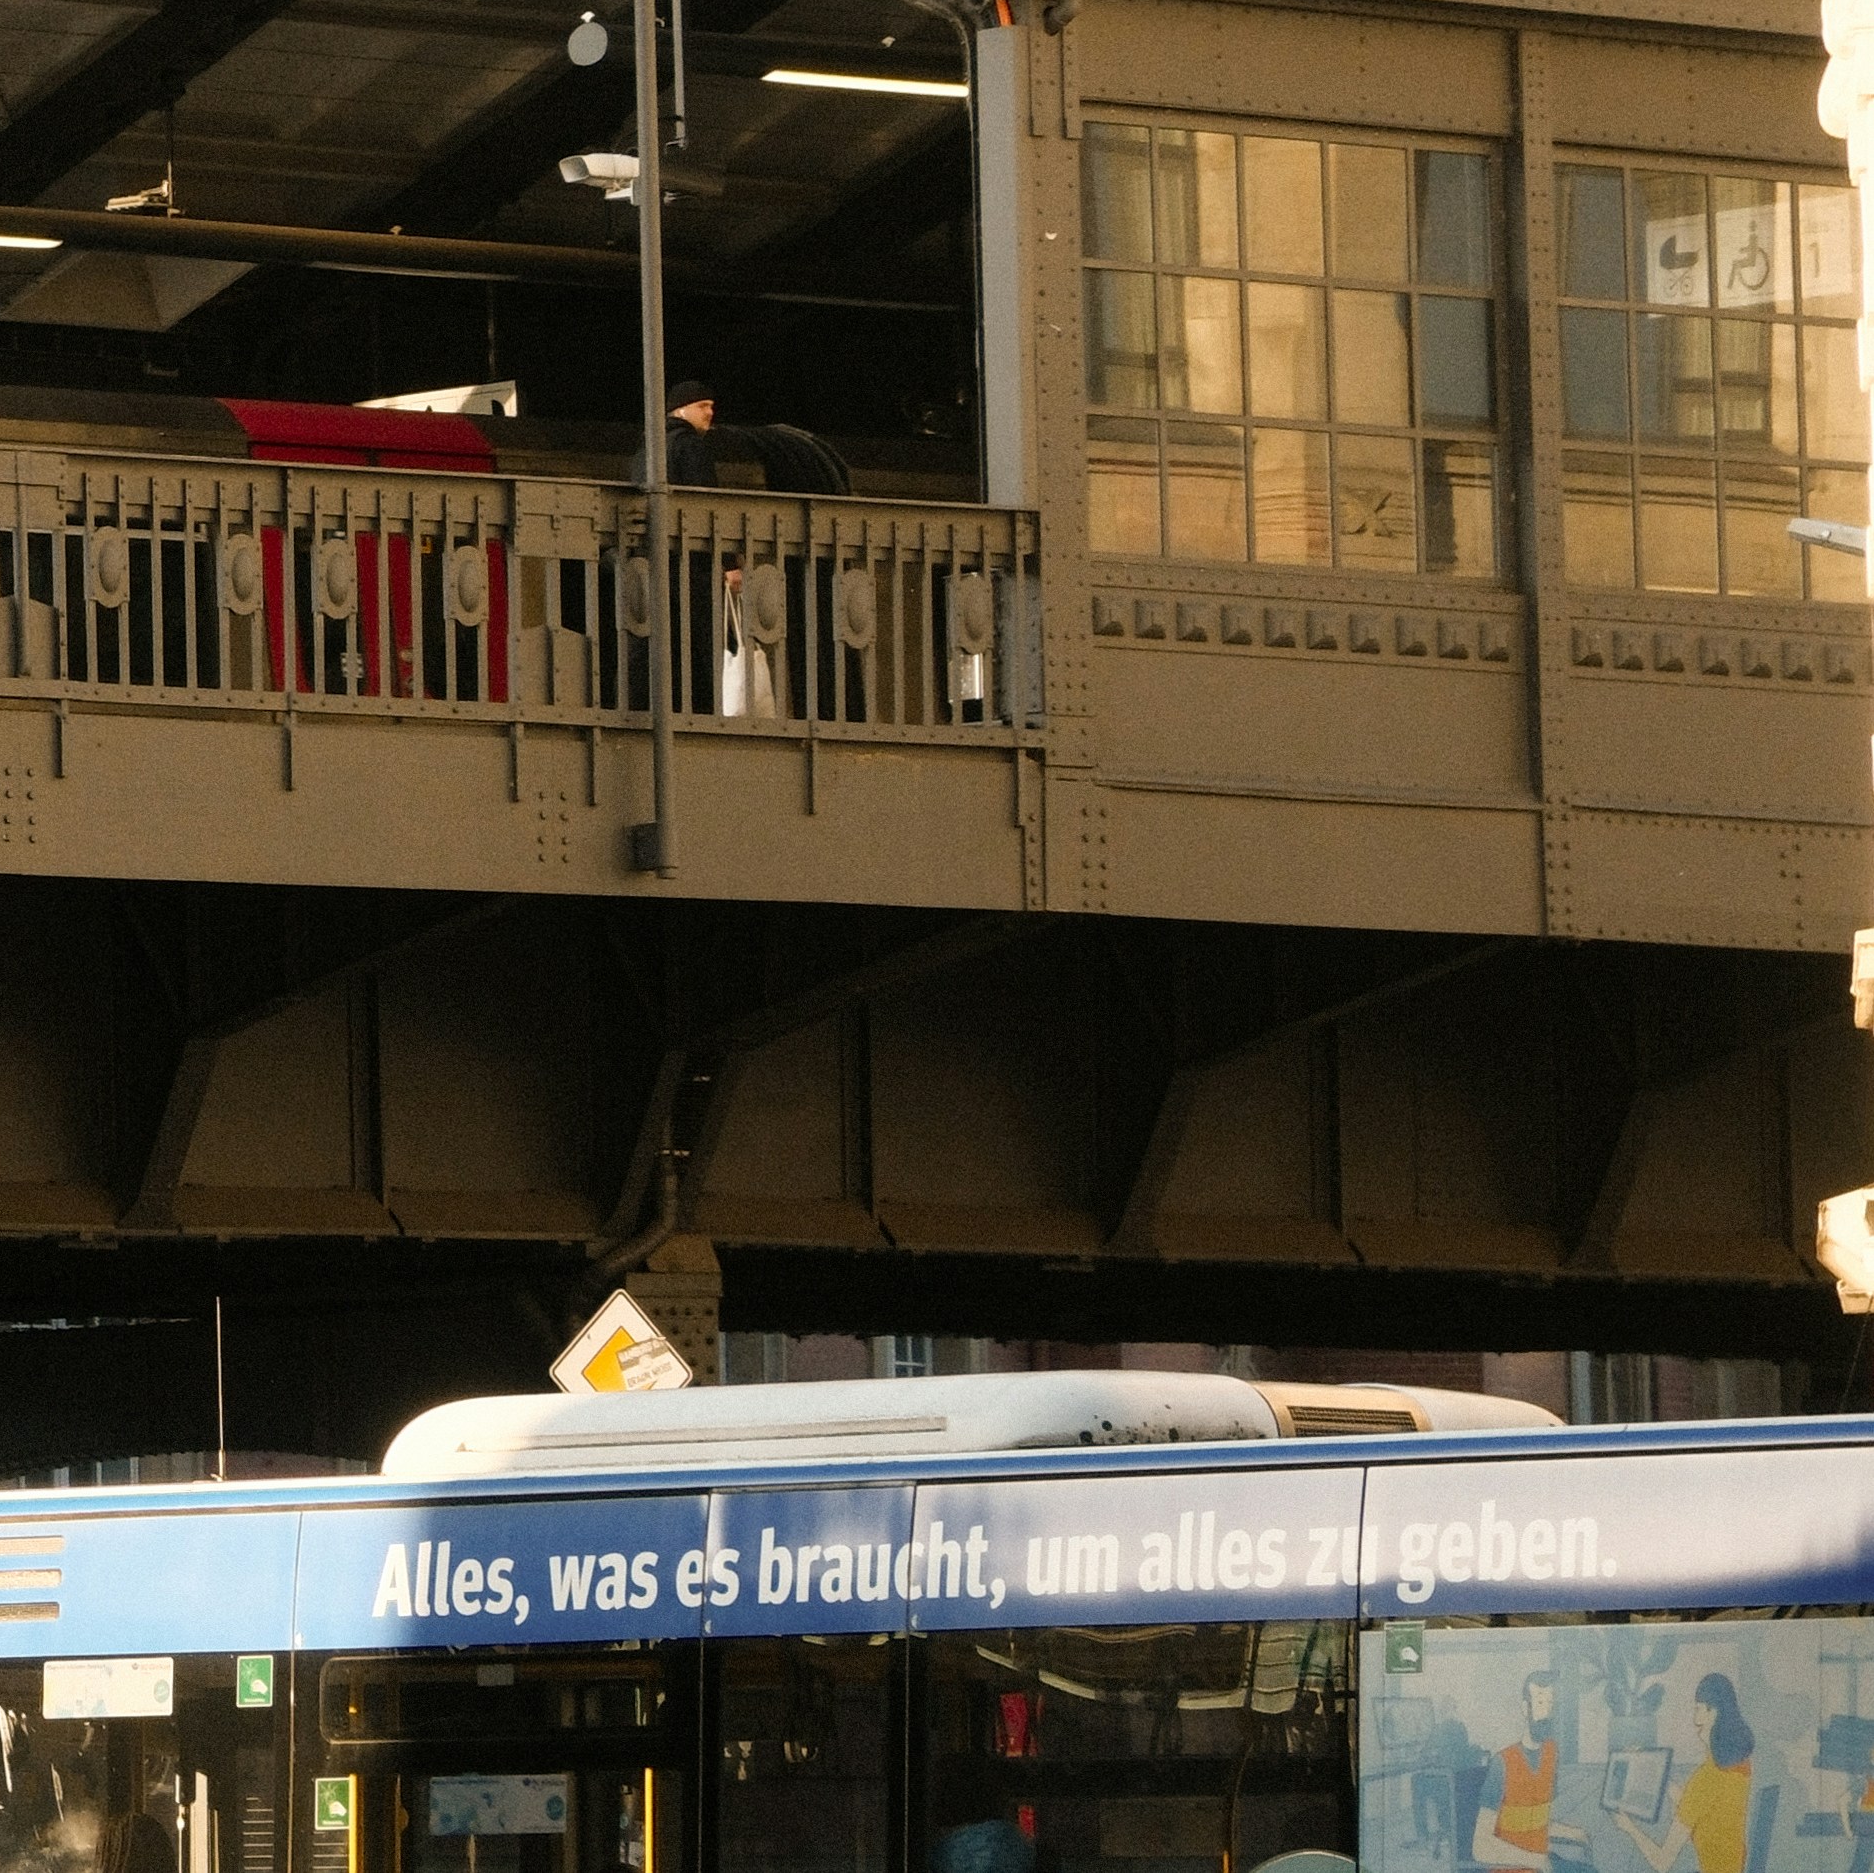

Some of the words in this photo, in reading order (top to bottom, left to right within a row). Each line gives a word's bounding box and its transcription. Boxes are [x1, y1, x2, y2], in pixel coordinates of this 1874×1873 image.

[372, 1539, 530, 1625] Alles,
[548, 1548, 658, 1612] was
[675, 1545, 740, 1608] es
[757, 1520, 1007, 1609] braucht,
[1026, 1531, 1120, 1596] um
[1137, 1510, 1287, 1593] alles
[1306, 1525, 1377, 1587] zu
[1396, 1499, 1618, 1604] geben.
